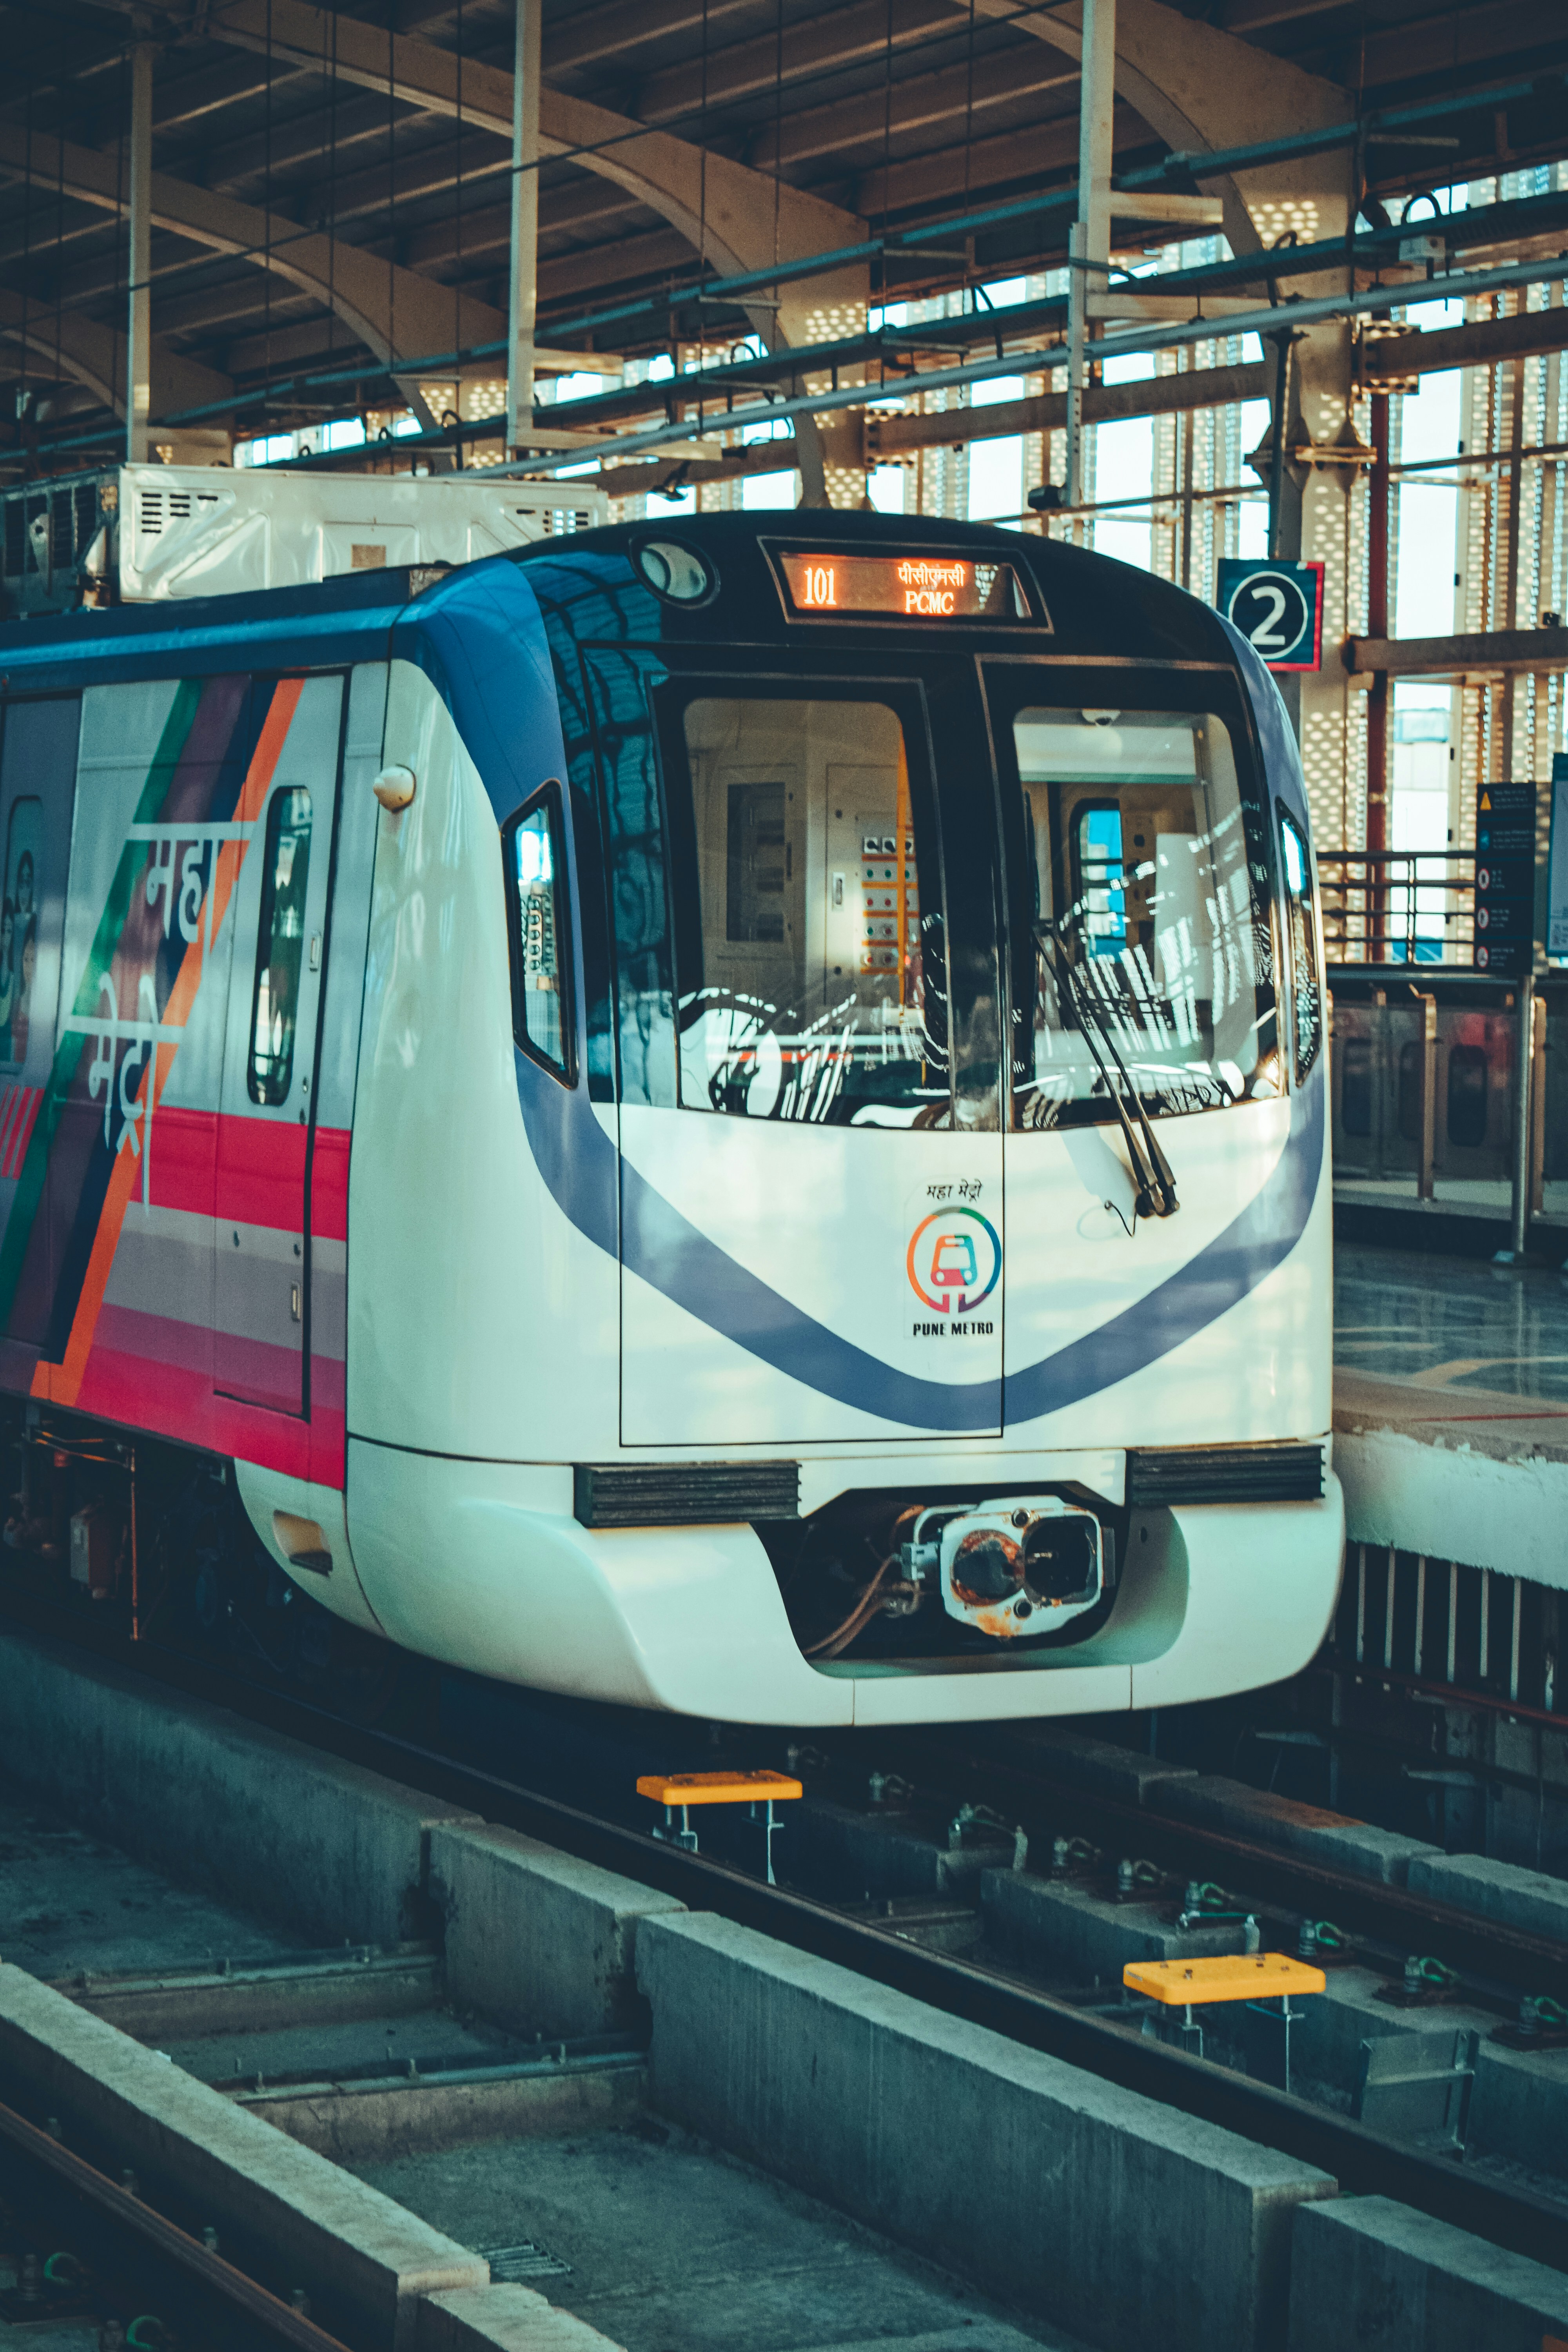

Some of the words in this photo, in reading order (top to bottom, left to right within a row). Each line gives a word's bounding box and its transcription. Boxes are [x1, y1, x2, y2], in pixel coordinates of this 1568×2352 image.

[804, 567, 837, 606] 101
[897, 563, 965, 587] पीसीएमसी
[905, 591, 954, 614] PCMC
[1250, 586, 1286, 645] 2
[127, 822, 255, 973] महा
[65, 974, 186, 1214] मेट्रो
[926, 1184, 953, 1201] महा
[958, 1178, 984, 1202] मेट्रो
[913, 1322, 946, 1336] PUNE
[951, 1322, 993, 1335] METRO
